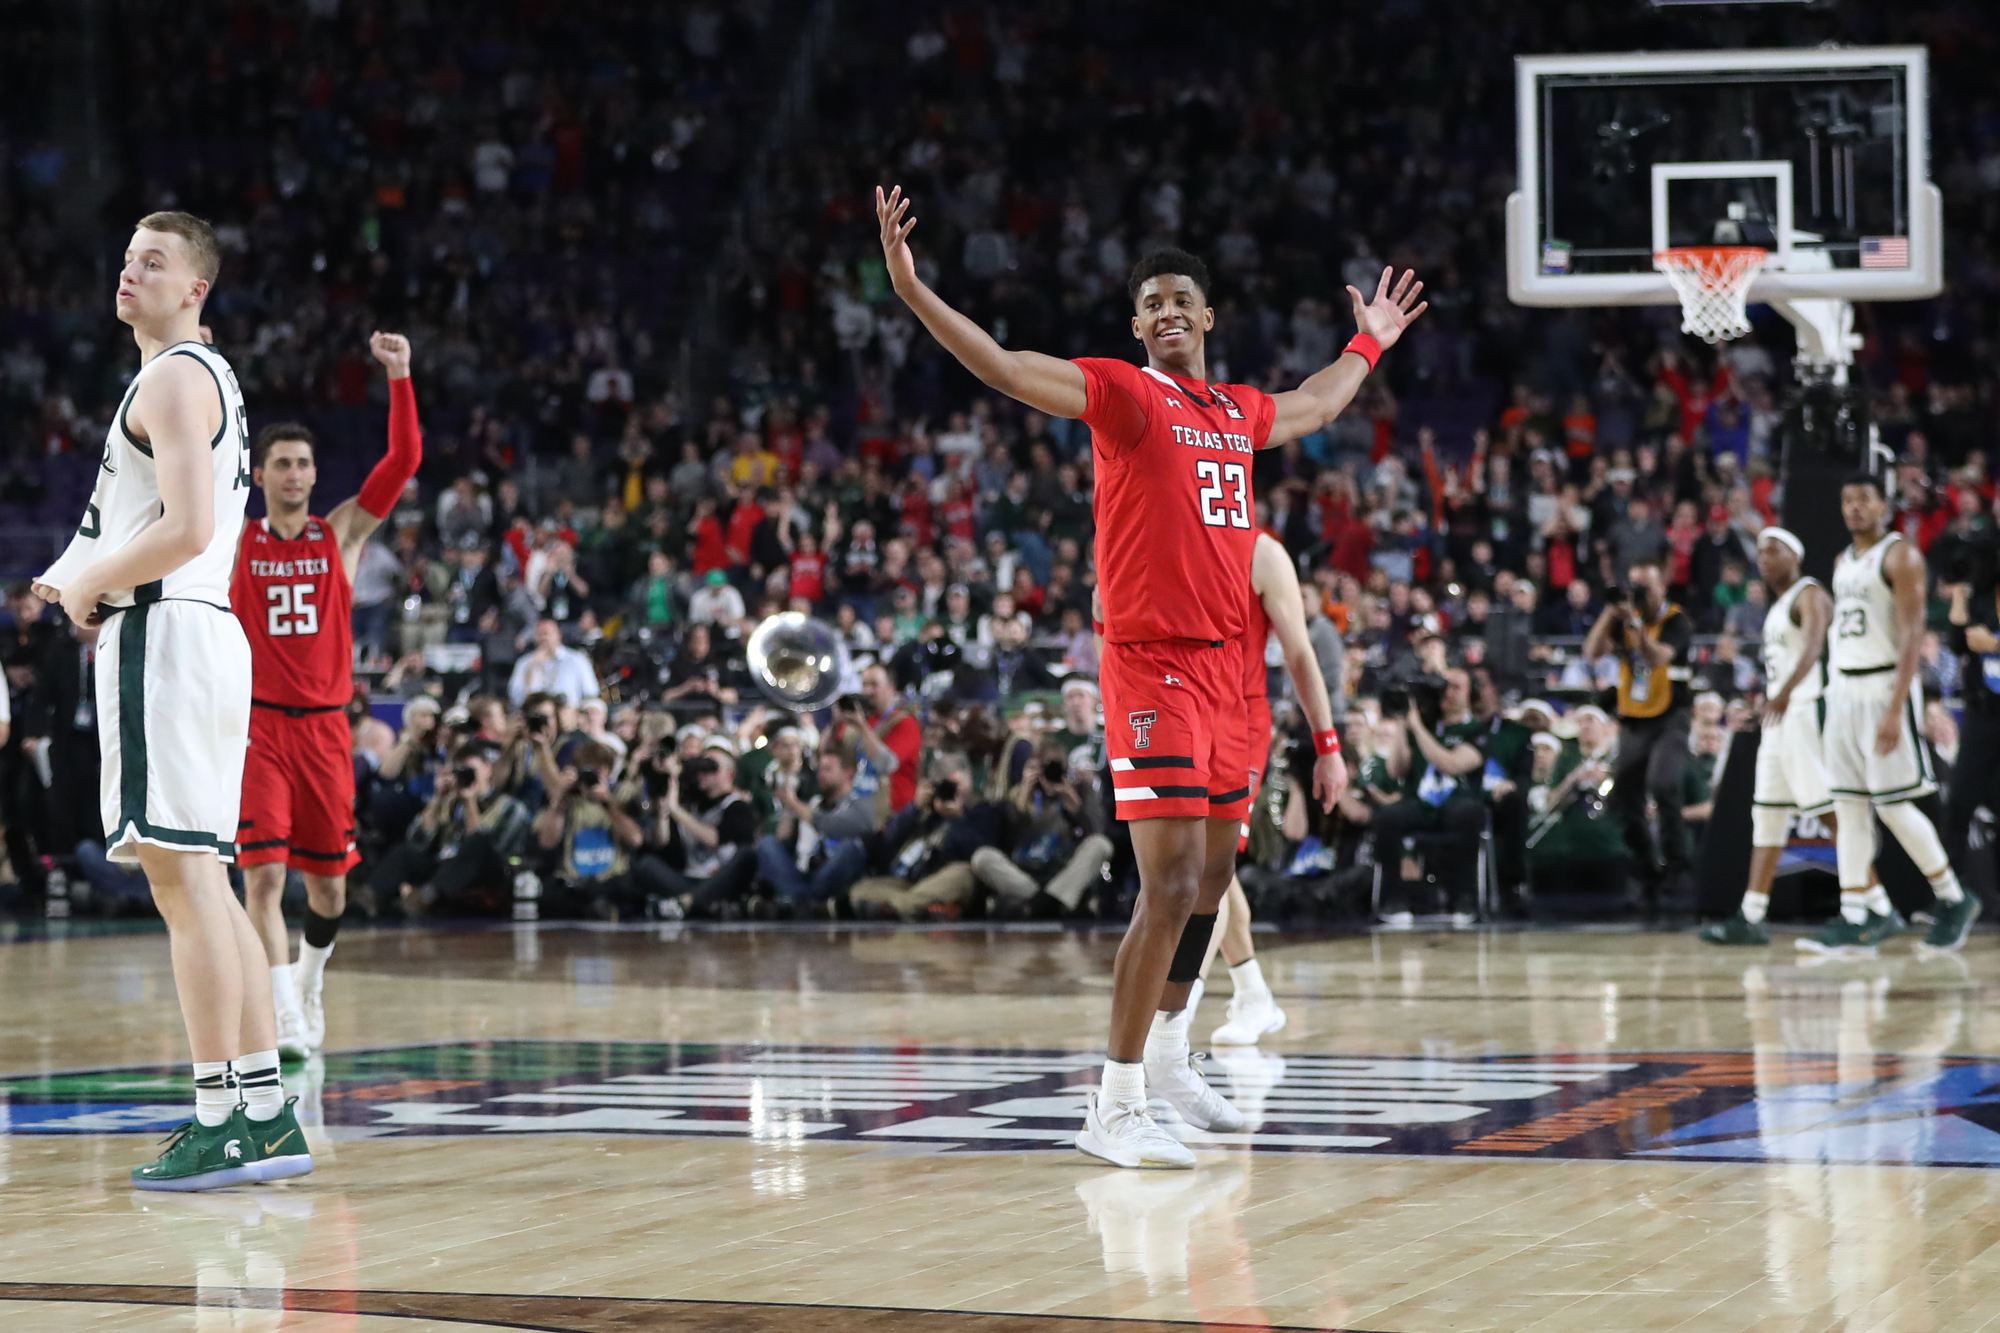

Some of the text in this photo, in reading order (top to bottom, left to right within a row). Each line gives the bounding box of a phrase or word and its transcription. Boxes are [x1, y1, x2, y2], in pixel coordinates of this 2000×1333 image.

[1171, 425, 1223, 450] TEXAS
[1196, 459, 1252, 529] 23
[250, 557, 330, 577] TEXAS TECH
[266, 583, 319, 636] 25
[1839, 607, 1867, 638] 23
[368, 1052, 1108, 1133] FINAL
